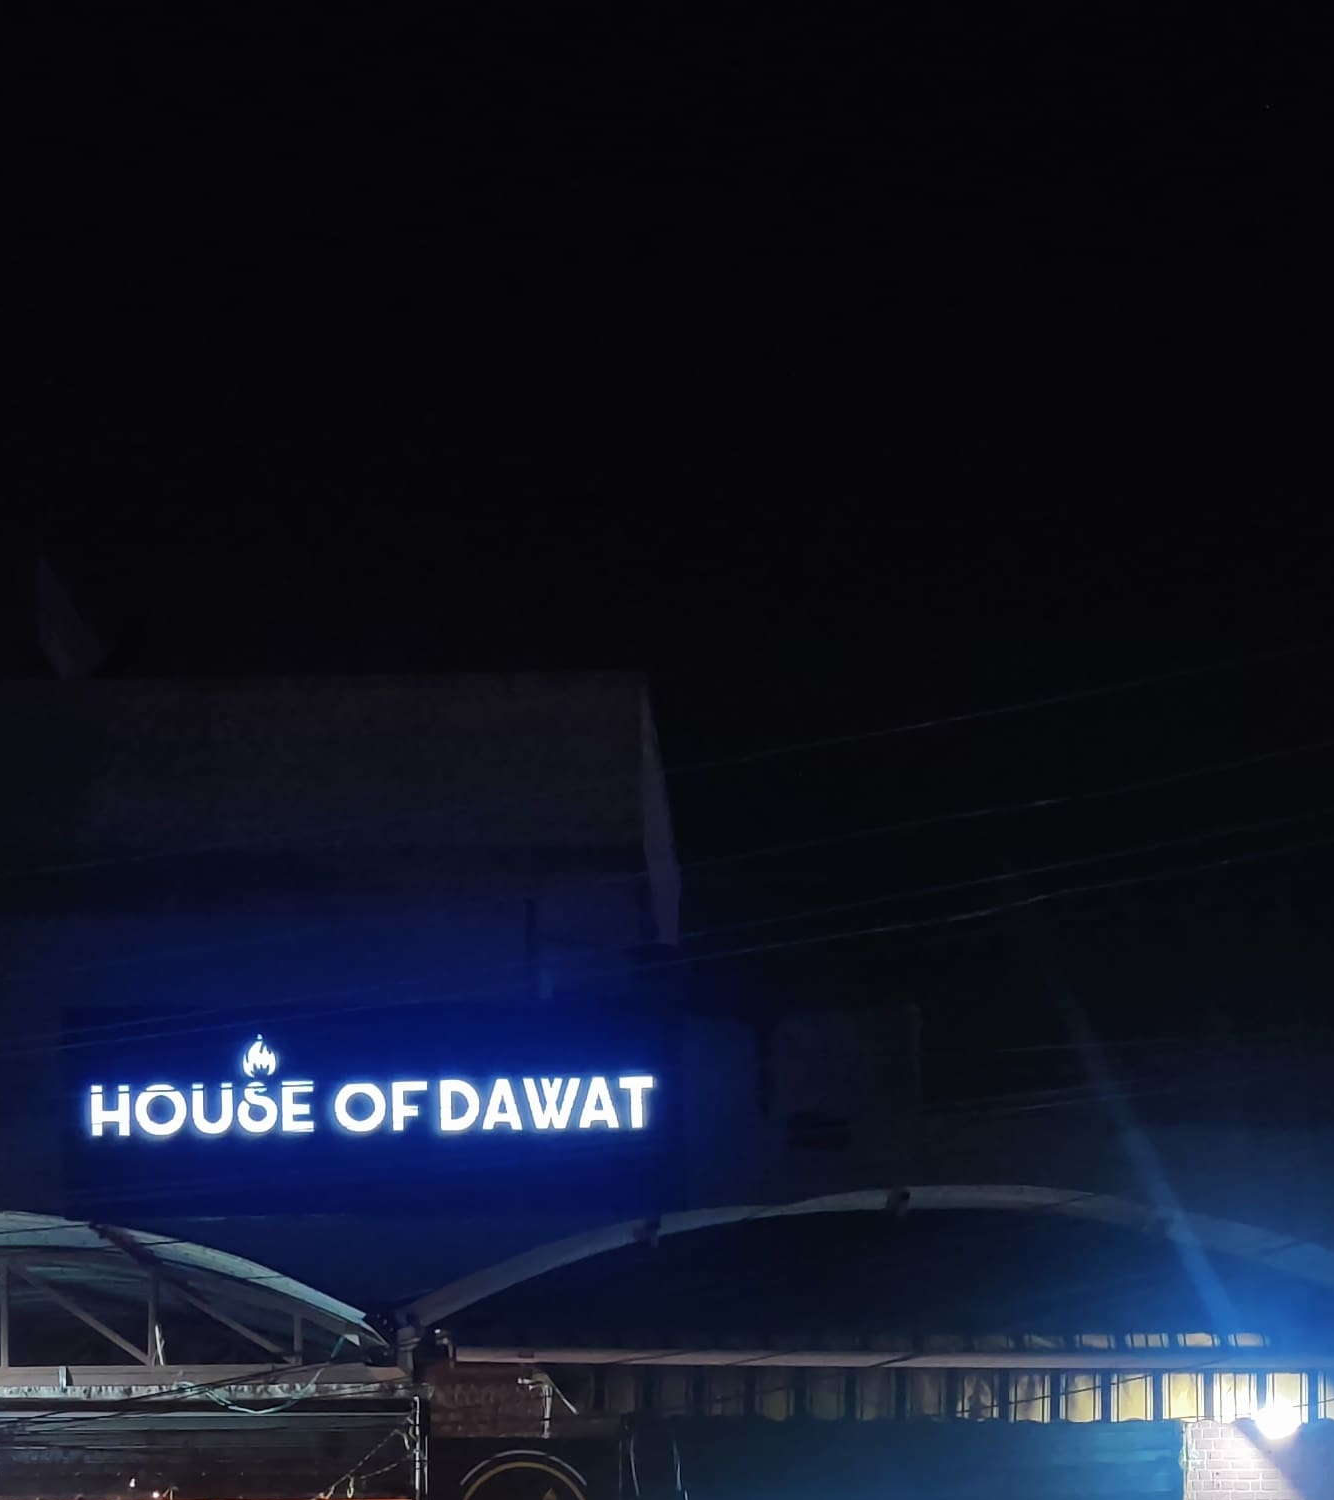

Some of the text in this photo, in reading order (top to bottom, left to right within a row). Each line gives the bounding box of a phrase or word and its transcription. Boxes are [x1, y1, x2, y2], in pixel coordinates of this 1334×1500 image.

[90, 1075, 655, 1137] HOUSE OF DAWAT
